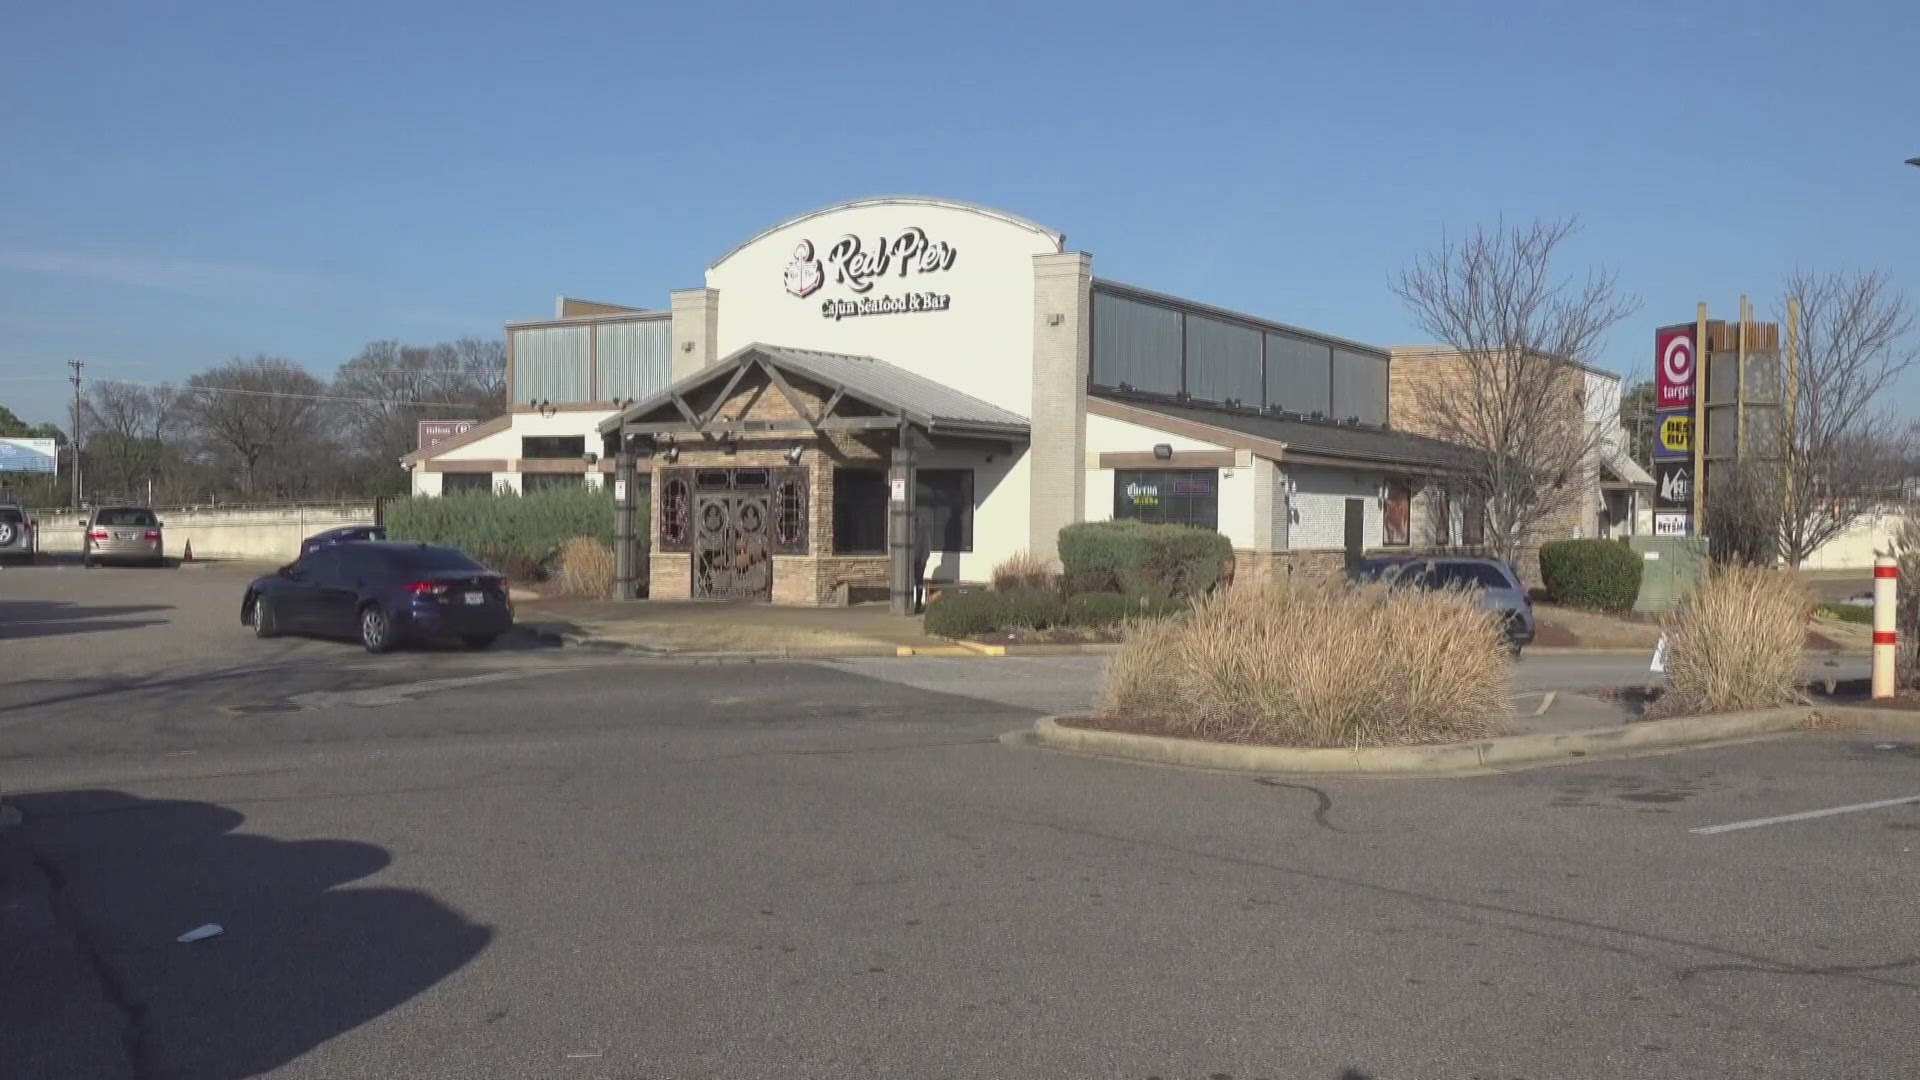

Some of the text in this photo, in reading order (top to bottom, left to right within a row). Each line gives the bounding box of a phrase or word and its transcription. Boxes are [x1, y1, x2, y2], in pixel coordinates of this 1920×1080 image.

[829, 227, 957, 293] Red Pier
[822, 291, 951, 321] Cajun Seafood & Bar
[1658, 520, 1694, 533] PETSM
